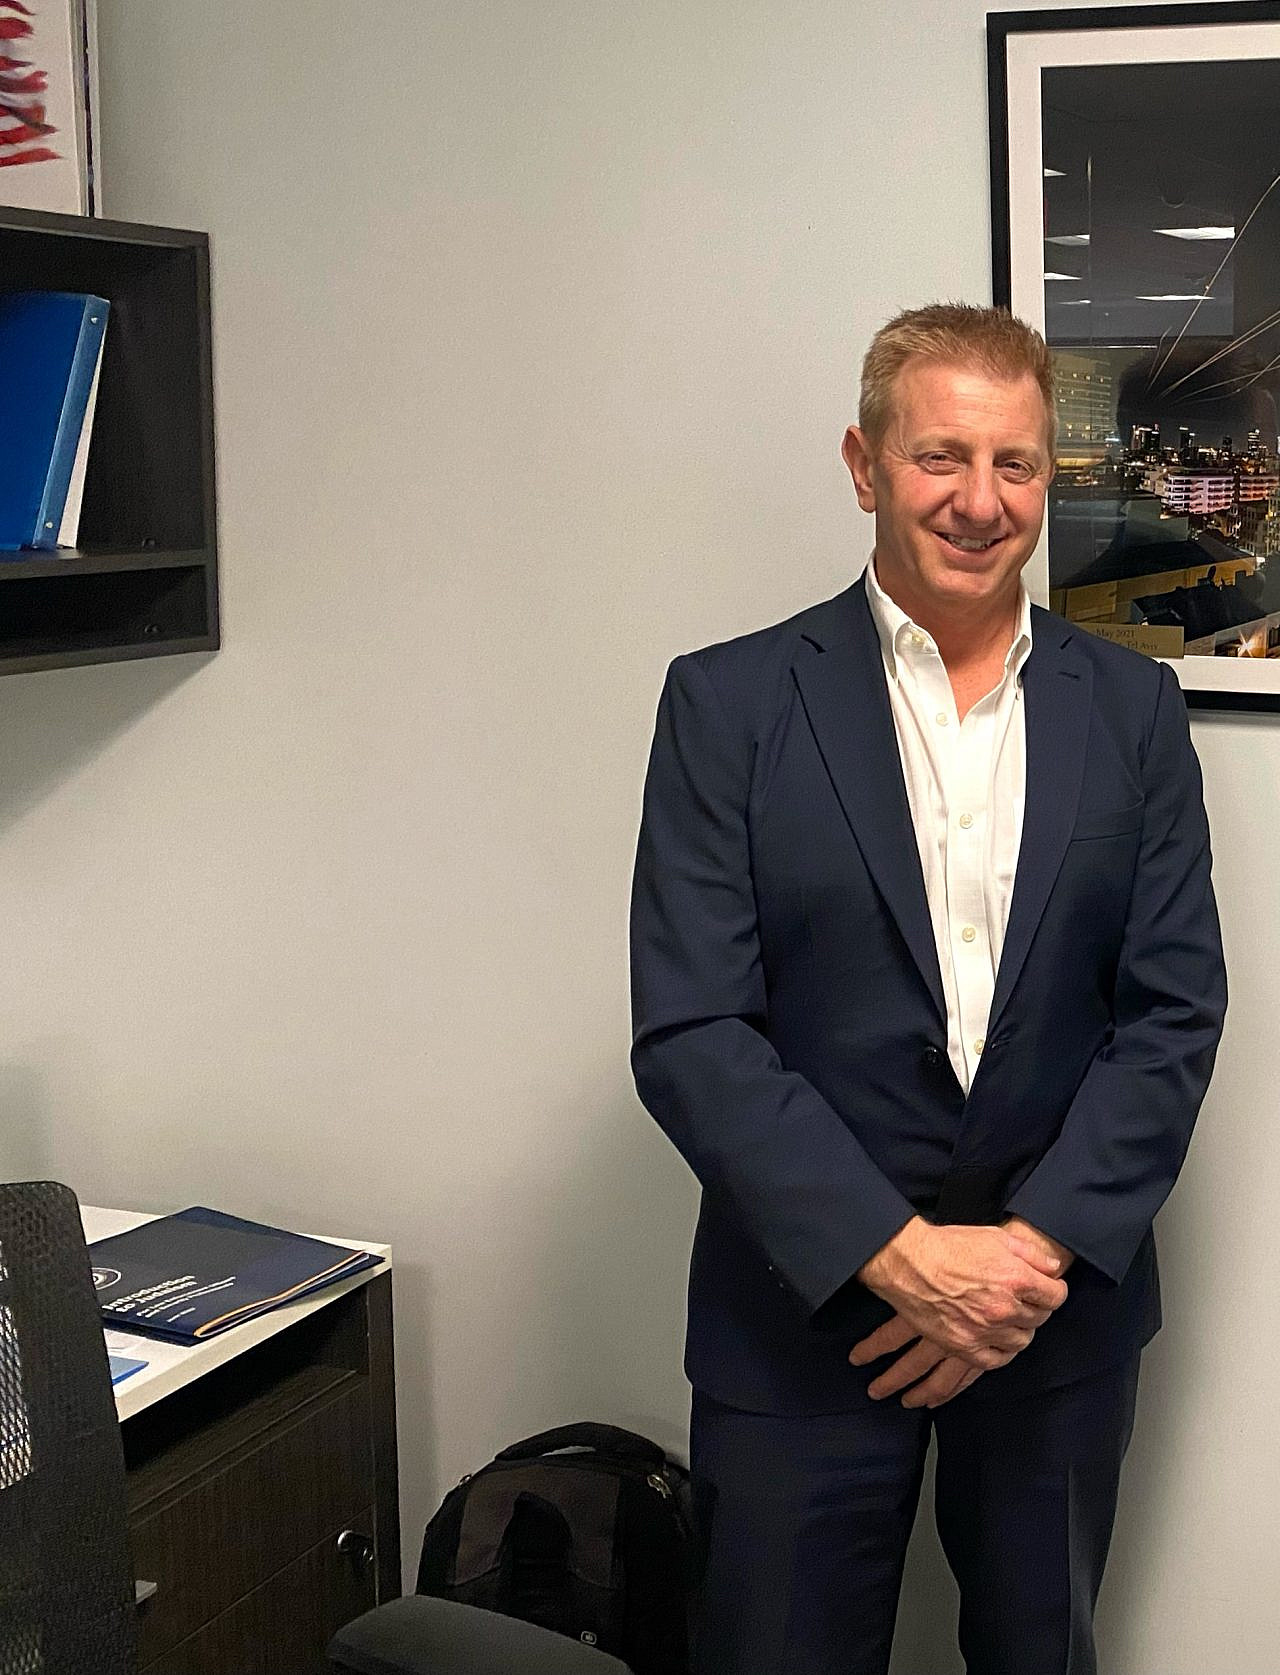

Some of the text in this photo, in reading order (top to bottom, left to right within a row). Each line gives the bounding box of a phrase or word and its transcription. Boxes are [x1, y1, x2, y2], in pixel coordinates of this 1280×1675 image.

[1096, 628, 1113, 639] May
[1127, 641, 1138, 650] Tel
[102, 1275, 196, 1310] Introduction
[115, 1303, 136, 1312] to
